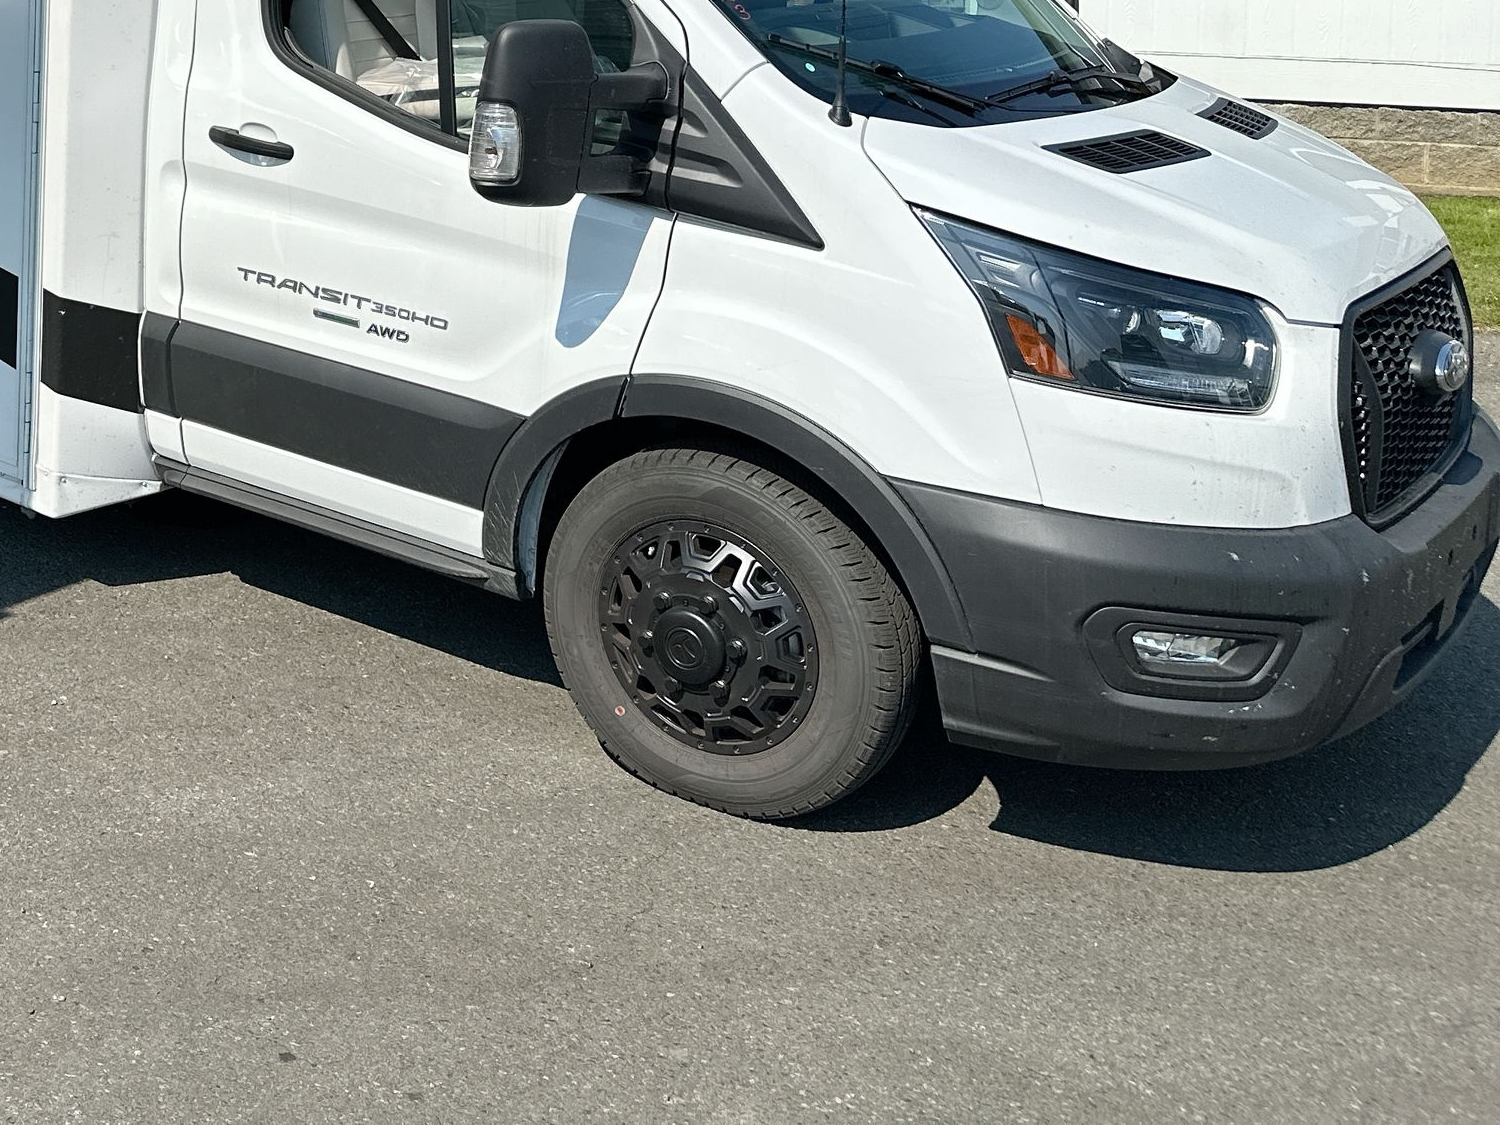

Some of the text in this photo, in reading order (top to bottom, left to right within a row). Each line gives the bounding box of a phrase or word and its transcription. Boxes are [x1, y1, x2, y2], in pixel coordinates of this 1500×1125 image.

[236, 266, 449, 331] TRANSIT 350HD
[366, 323, 410, 344] AWD
